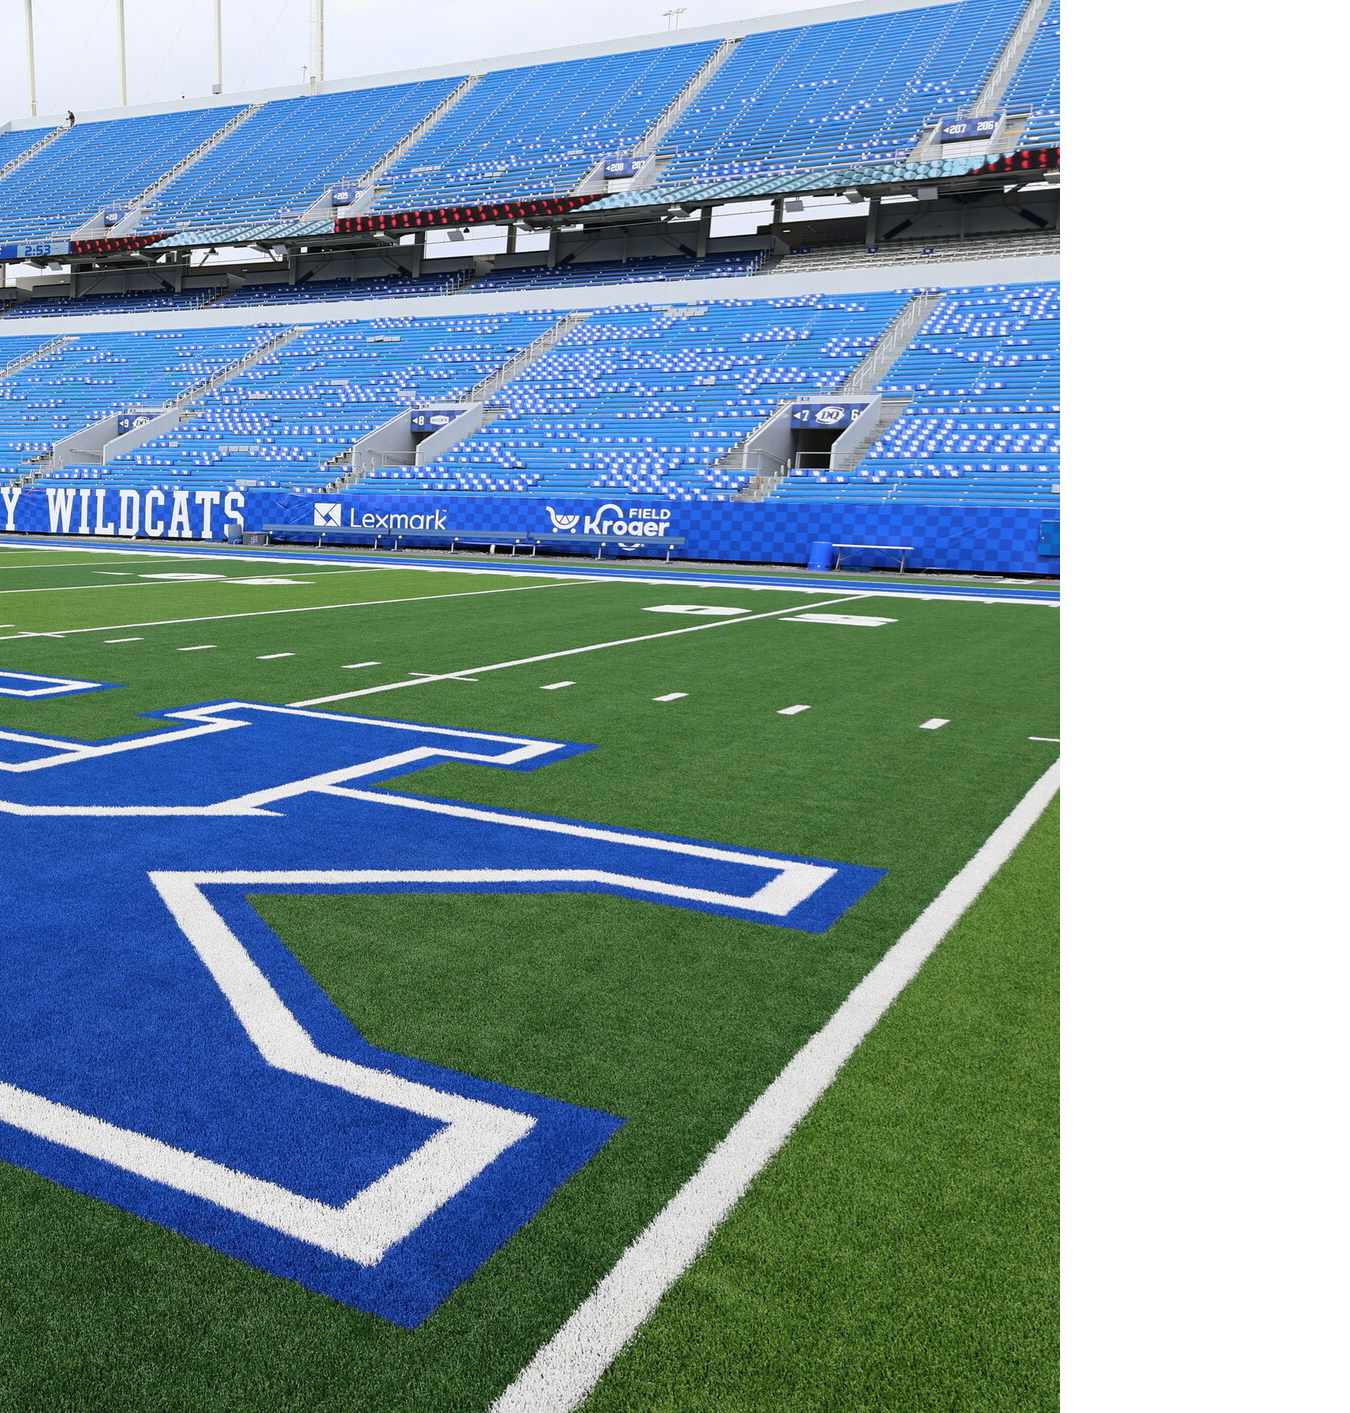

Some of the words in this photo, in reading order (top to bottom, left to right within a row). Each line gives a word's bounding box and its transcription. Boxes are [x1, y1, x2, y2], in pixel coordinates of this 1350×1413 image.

[949, 124, 966, 134] 207
[976, 121, 994, 131] 206
[25, 244, 51, 257] 2:53
[802, 410, 810, 421] 7
[124, 419, 130, 428] 9
[46, 487, 245, 539] WILDCATS
[350, 507, 447, 530] Lexmark
[629, 508, 671, 520] FIELD
[583, 503, 671, 551] Kroger
